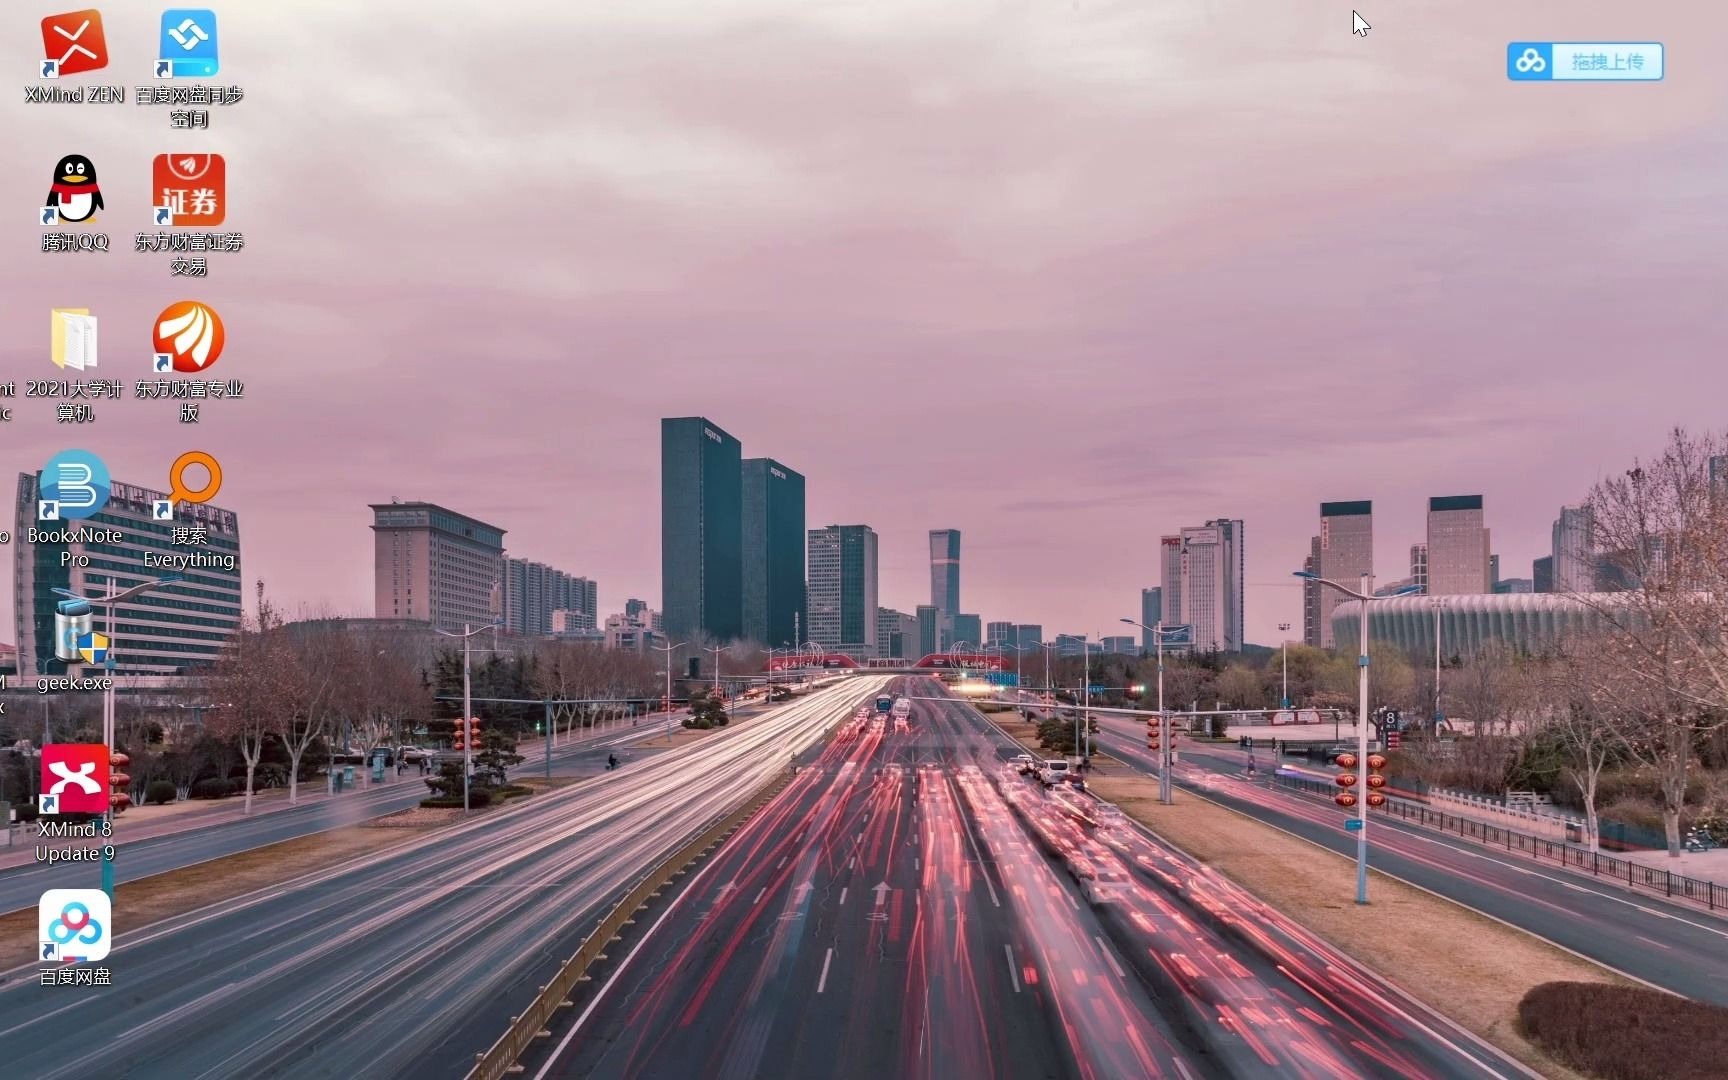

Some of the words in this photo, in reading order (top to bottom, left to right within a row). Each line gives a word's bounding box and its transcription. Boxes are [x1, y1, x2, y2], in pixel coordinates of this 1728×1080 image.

[1572, 52, 1645, 71] 拖拽上传
[25, 86, 82, 102] XMind
[88, 86, 123, 102] ZEN
[135, 86, 243, 104] 百度网盘同步
[171, 110, 207, 127] 空间
[42, 233, 108, 251] 腾讯QQ
[135, 233, 243, 251] 东方财富证券
[171, 257, 207, 276] 交易
[26, 380, 124, 398] 2021大学计
[135, 380, 243, 398] 东方财富专业
[57, 403, 94, 422] 算机
[180, 403, 199, 422] 版
[28, 527, 122, 543] BookxNote
[171, 527, 207, 545] 搜索
[61, 551, 89, 567] Pro
[144, 551, 234, 571] Everything
[37, 674, 112, 694] geek.exe
[1386, 712, 1395, 724] 8
[38, 821, 95, 837] XMind
[101, 821, 112, 837] 8
[36, 845, 99, 865] Update
[104, 845, 115, 861] 9
[39, 966, 111, 986] 百度网盘
